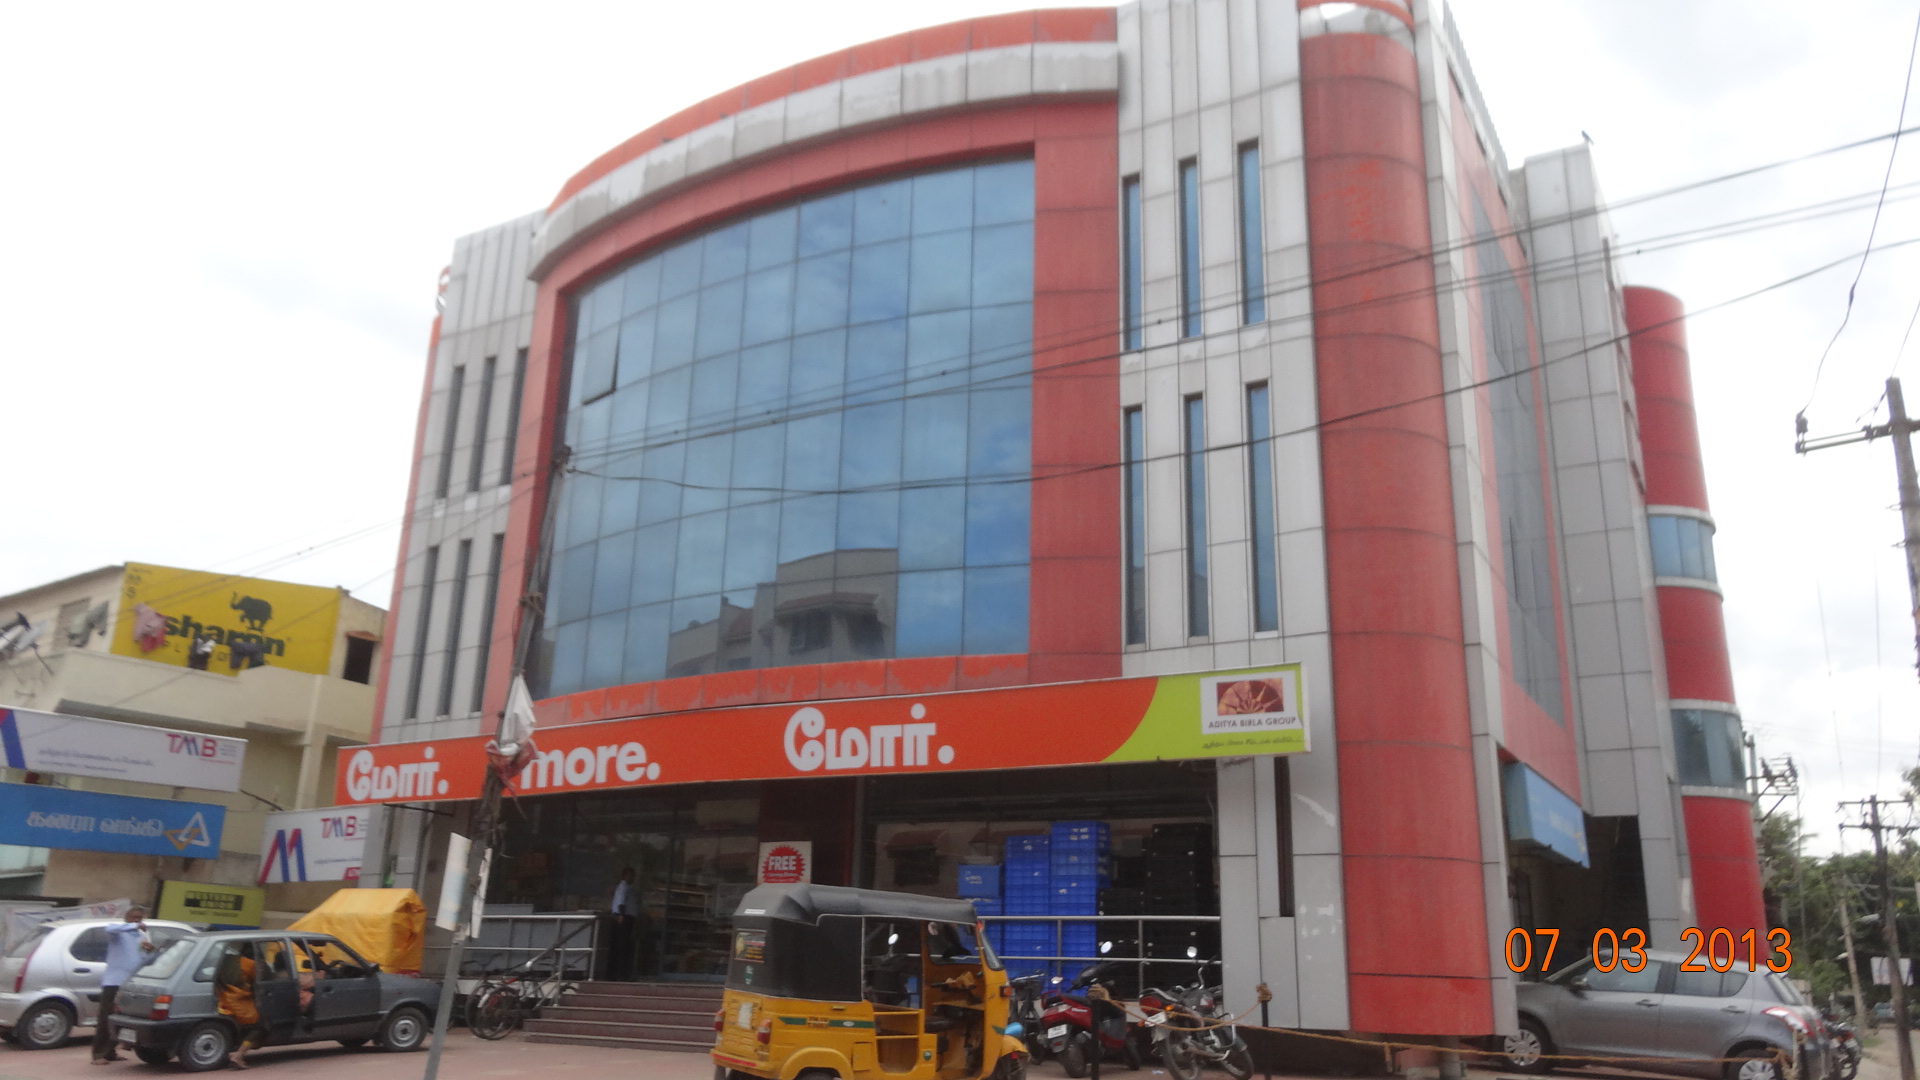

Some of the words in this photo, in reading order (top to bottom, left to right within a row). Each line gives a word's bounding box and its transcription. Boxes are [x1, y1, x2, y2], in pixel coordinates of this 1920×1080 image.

[1208, 719, 1237, 729] ADITYA
[1240, 718, 1262, 727] BIRLA
[1265, 716, 1296, 726] GROUP
[166, 733, 218, 758] TMB
[783, 703, 955, 772] மோர்.
[346, 747, 449, 801] மோர்.
[520, 742, 661, 790] more.
[320, 815, 357, 838] TMB
[768, 855, 797, 871] FREE
